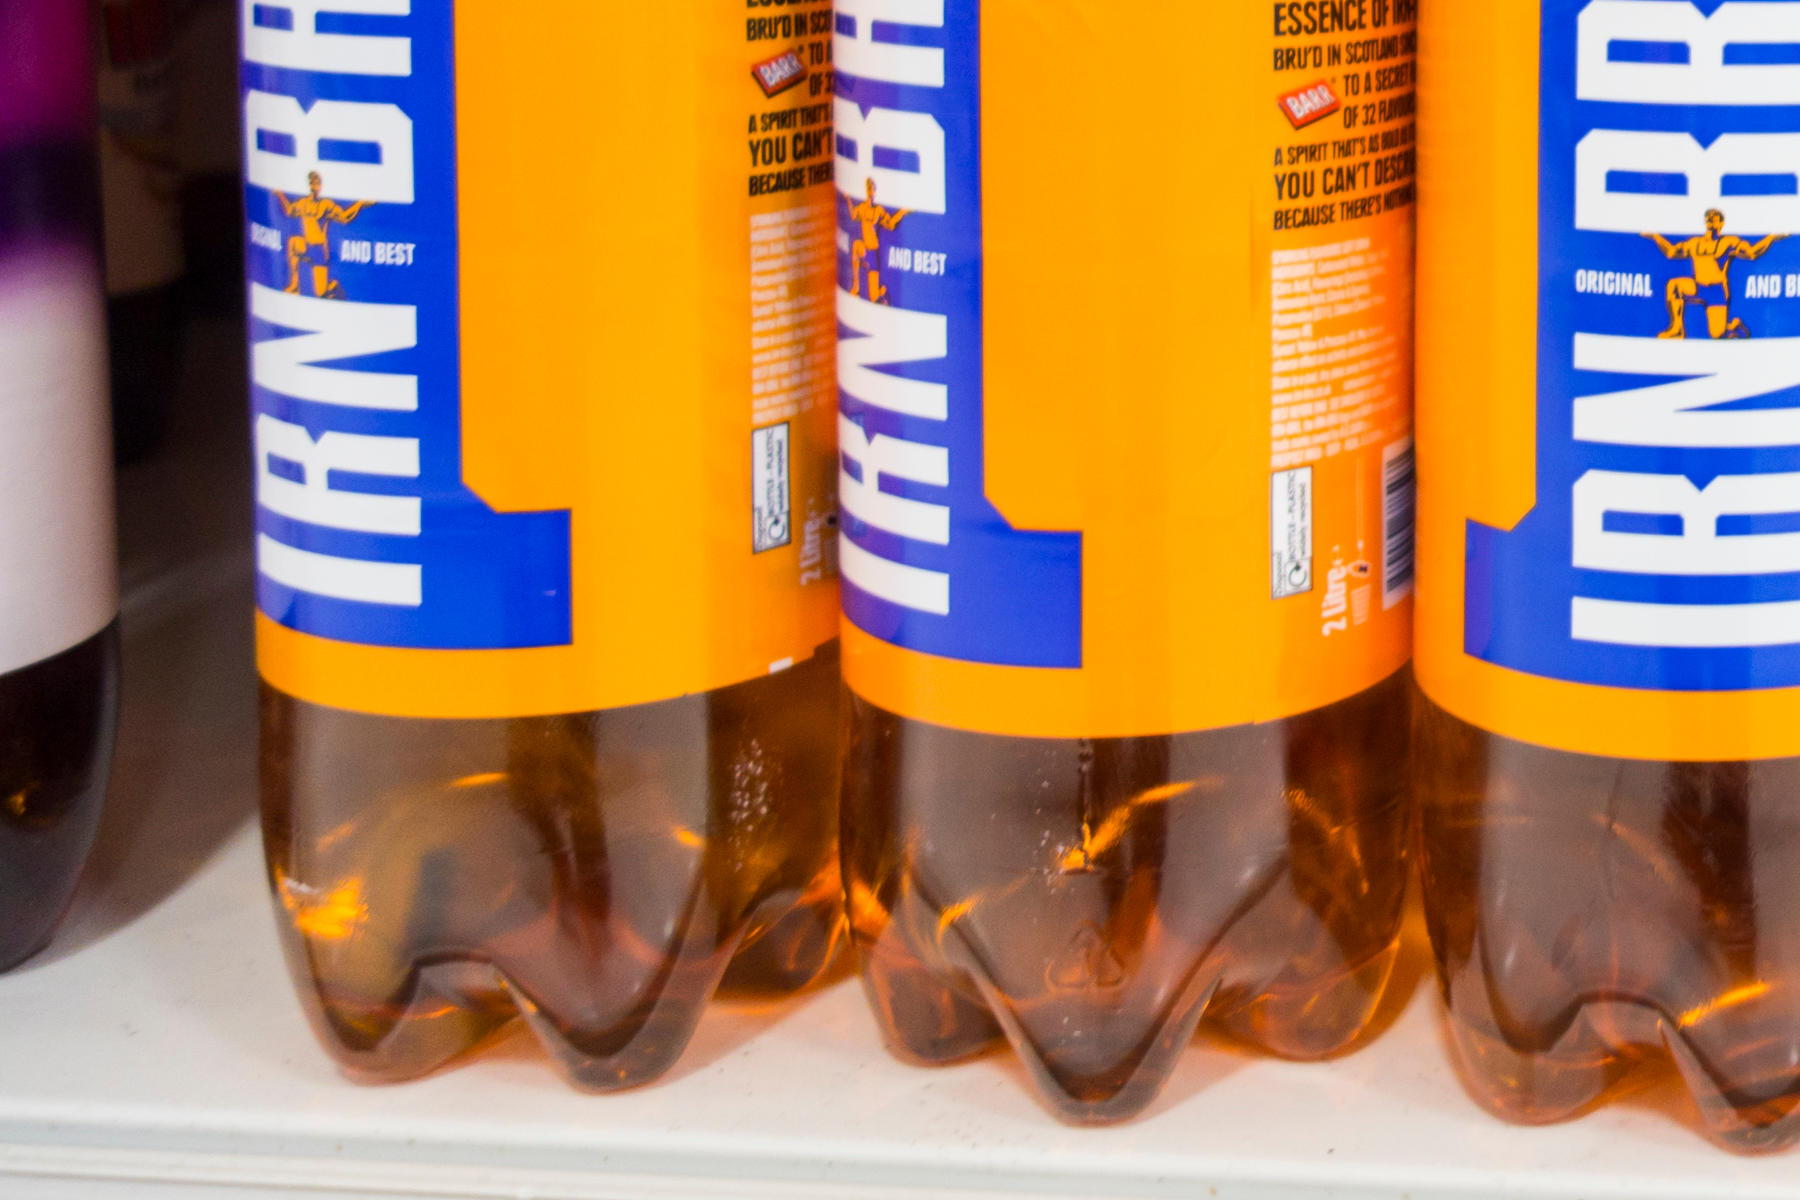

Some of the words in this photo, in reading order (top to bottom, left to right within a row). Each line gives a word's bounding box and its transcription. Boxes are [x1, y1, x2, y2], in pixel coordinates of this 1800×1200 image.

[795, 11, 807, 37] IN
[1273, 45, 1323, 71] BRU'D
[1327, 44, 1341, 67] IN
[1345, 35, 1399, 65] SCOTLAND
[1343, 74, 1360, 96] TO
[1364, 71, 1372, 94] A
[1343, 105, 1359, 129] OF
[1362, 103, 1376, 126] 32
[749, 136, 786, 168] YOU
[1274, 148, 1283, 166] A
[1287, 141, 1328, 165] SPIRIT
[1332, 136, 1366, 159] THAT'S
[749, 168, 806, 197] BECAUSE
[1274, 171, 1314, 201] YOU
[1322, 161, 1370, 196] CAN'T
[1273, 201, 1336, 231] BECAUSE
[1340, 194, 1382, 222] THERE'S
[340, 239, 371, 264] AND
[374, 242, 416, 266] BEST
[888, 246, 912, 271] AND
[914, 250, 947, 276] BEST
[1575, 268, 1652, 297] ORIGINAL
[1745, 274, 1780, 299] AND
[251, 281, 422, 607] IRN
[837, 283, 950, 615] IRN
[1321, 616, 1347, 636] 2
